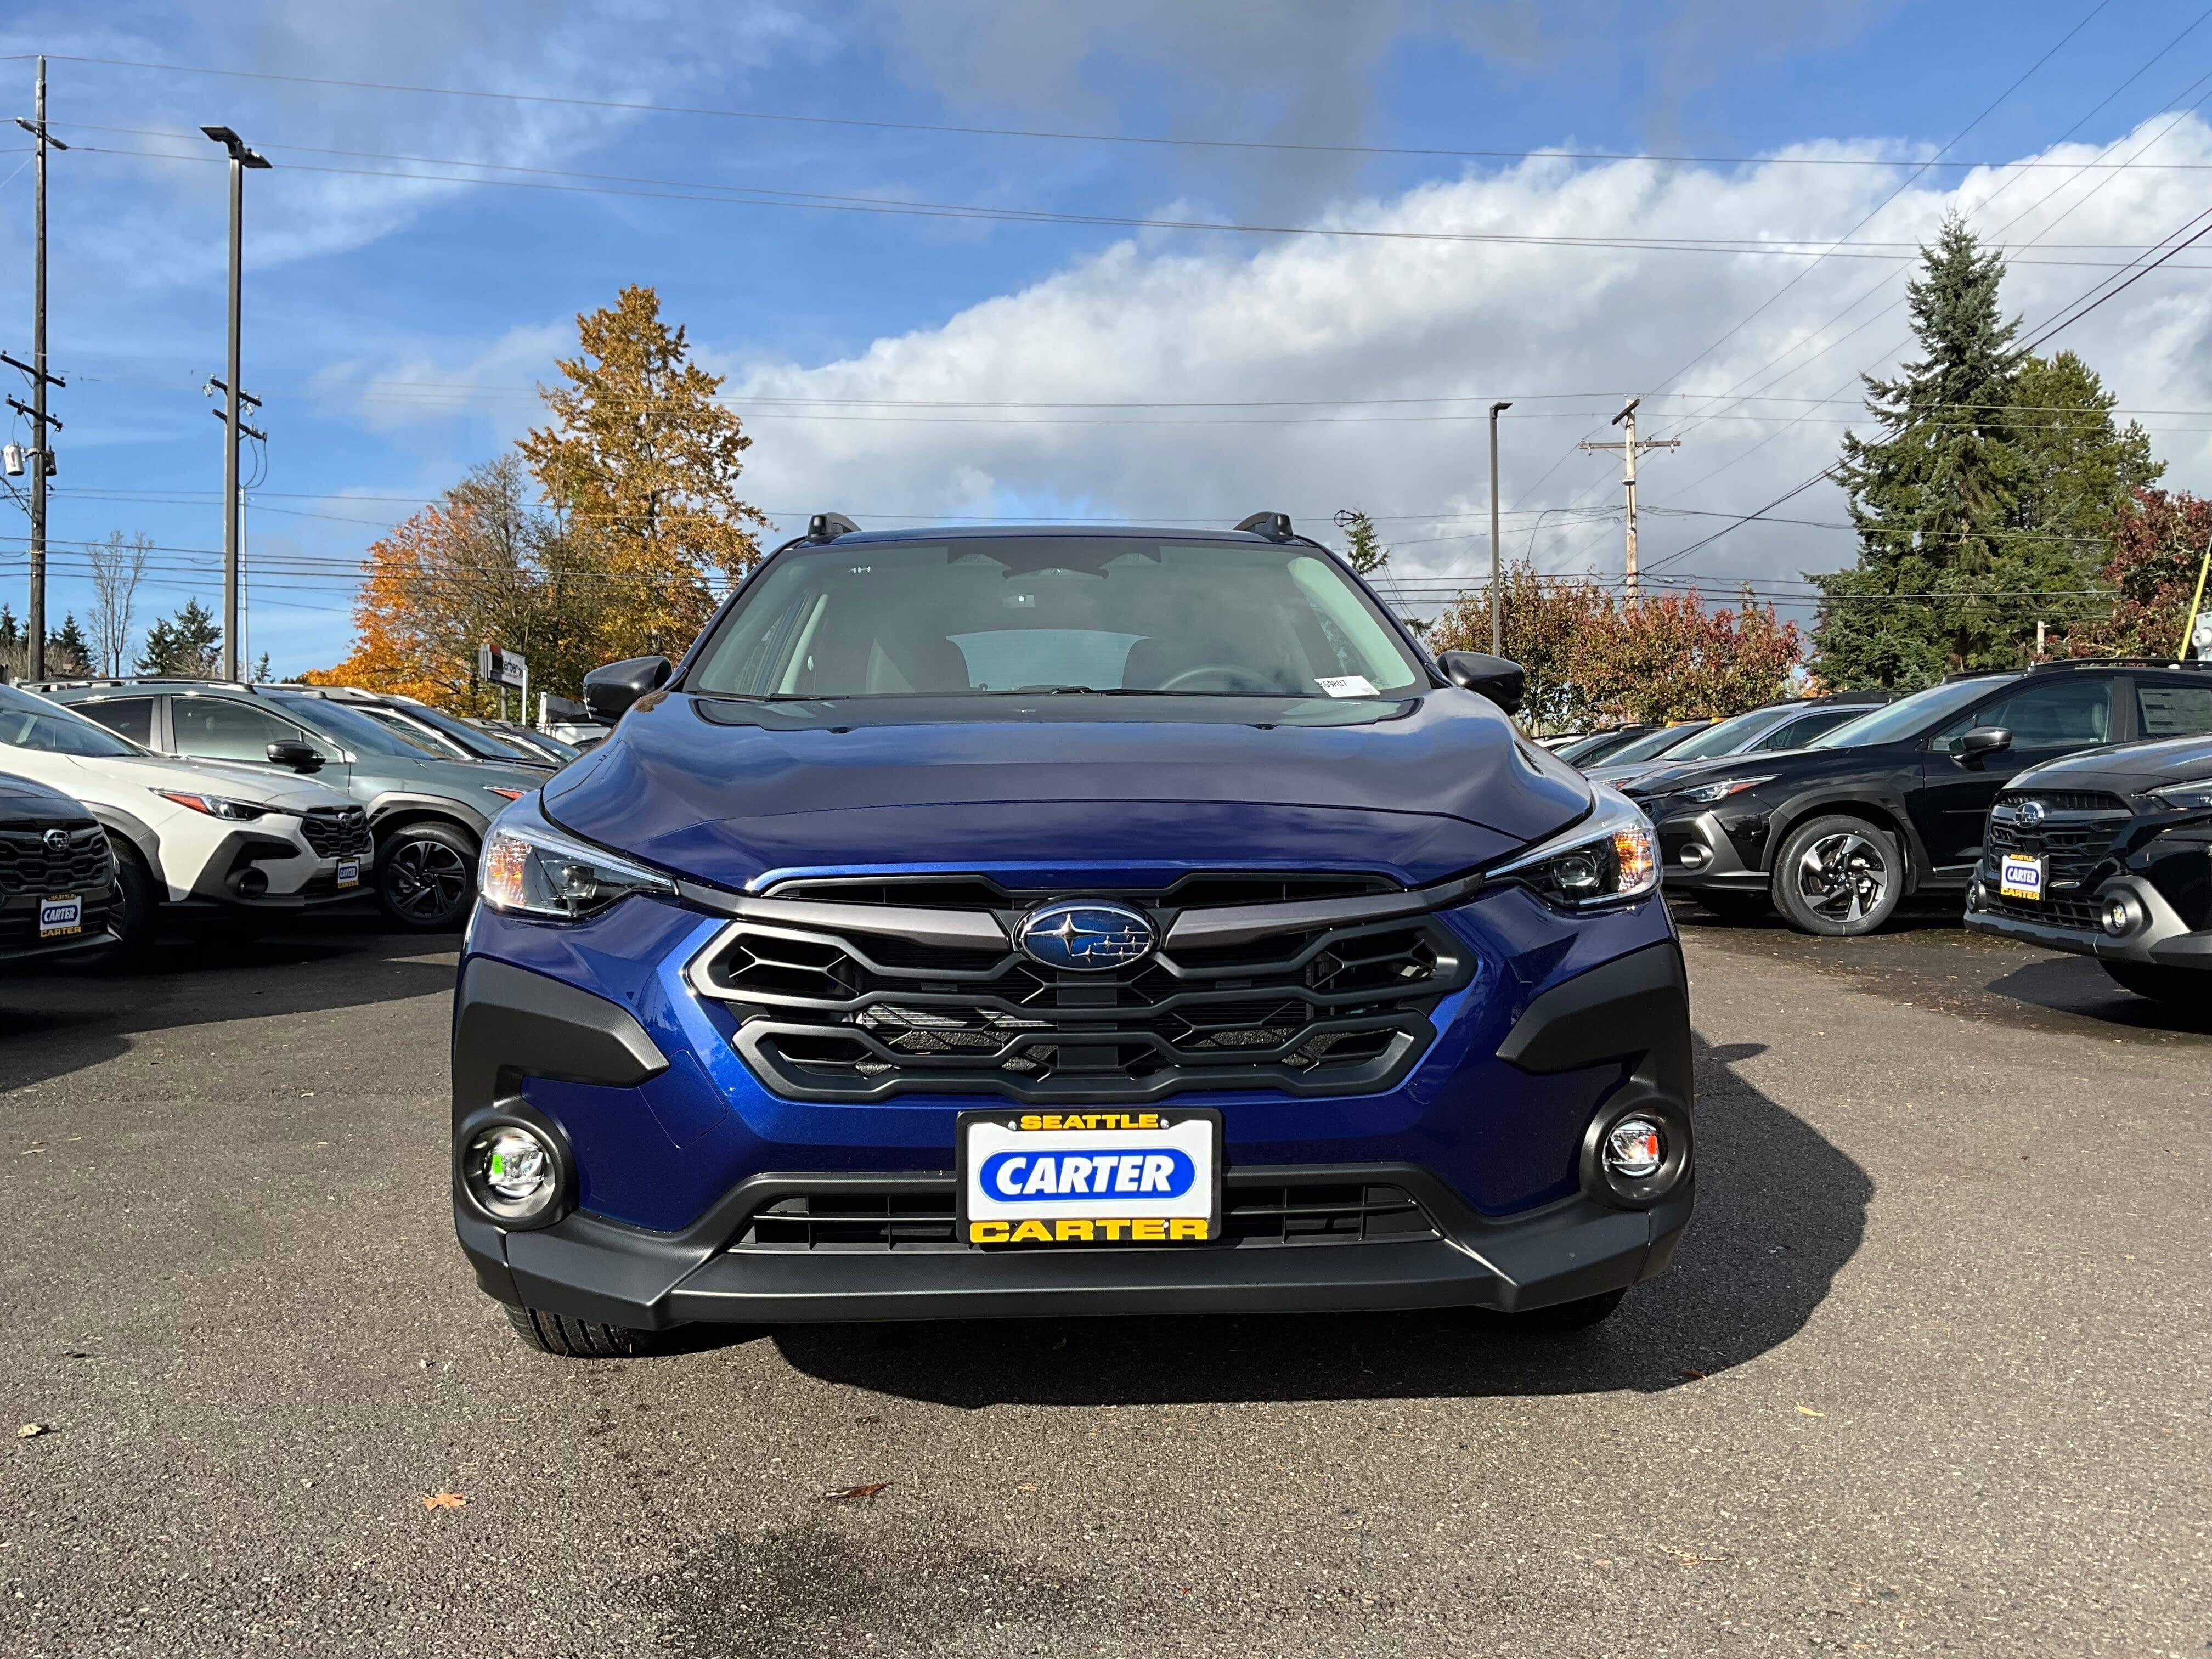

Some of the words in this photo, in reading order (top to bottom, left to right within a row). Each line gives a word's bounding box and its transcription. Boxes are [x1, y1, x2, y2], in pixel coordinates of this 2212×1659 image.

[2008, 867, 2036, 884] CARTER
[2001, 887, 2040, 900] CARTER
[44, 907, 75, 922] CARTER
[40, 926, 81, 938] CARTER
[1020, 1114, 1159, 1130] SEATTLE
[996, 1155, 1175, 1195] CARTER
[970, 1218, 1208, 1243] CARTER
